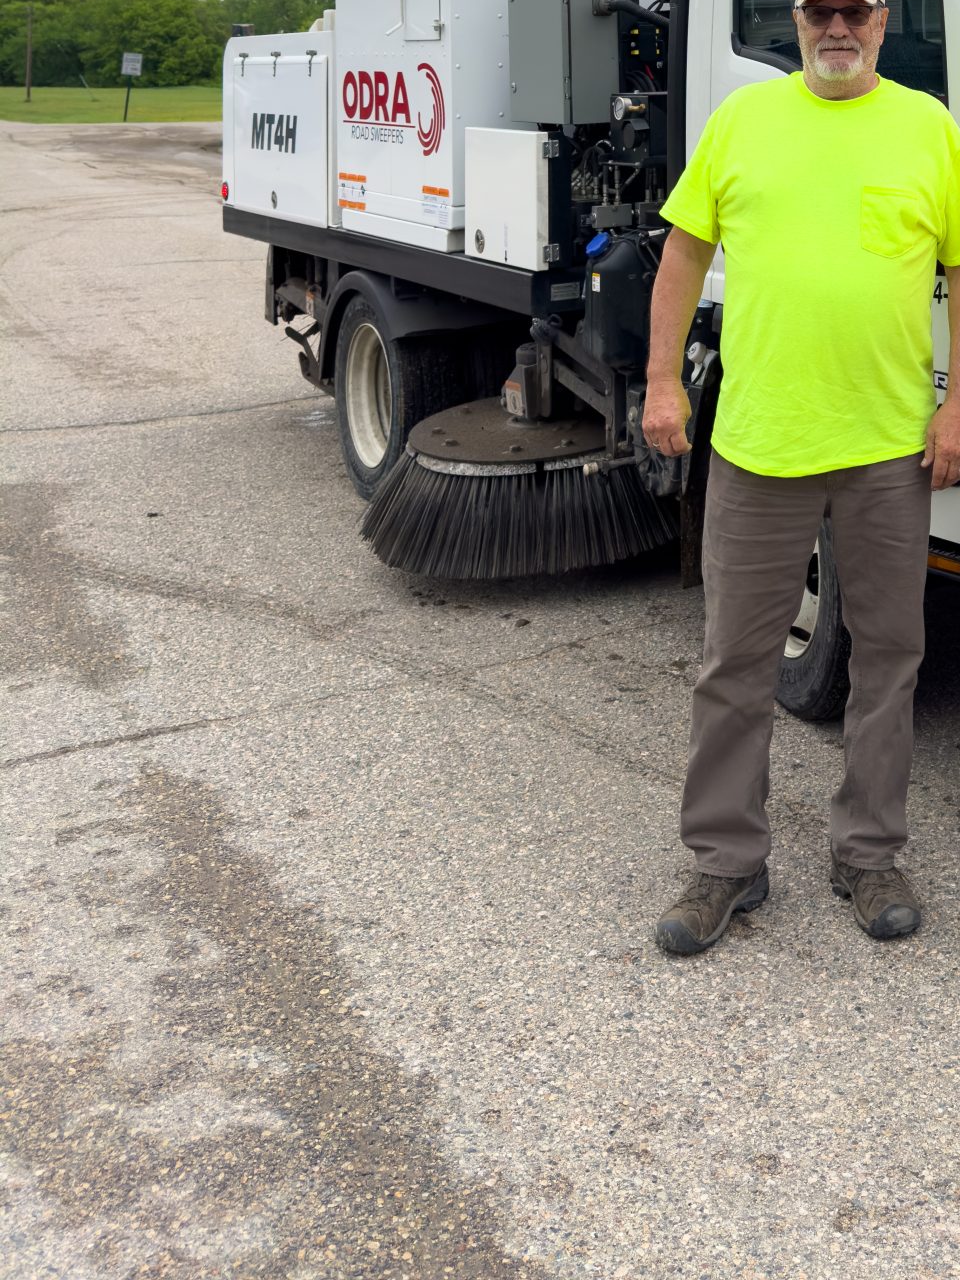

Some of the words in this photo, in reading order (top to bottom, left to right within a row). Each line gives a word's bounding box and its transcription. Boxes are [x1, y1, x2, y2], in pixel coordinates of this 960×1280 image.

[343, 71, 411, 124] ODRA
[251, 113, 297, 154] MT4H
[351, 125, 369, 140] ROAD
[370, 127, 404, 145] SWEEPERS
